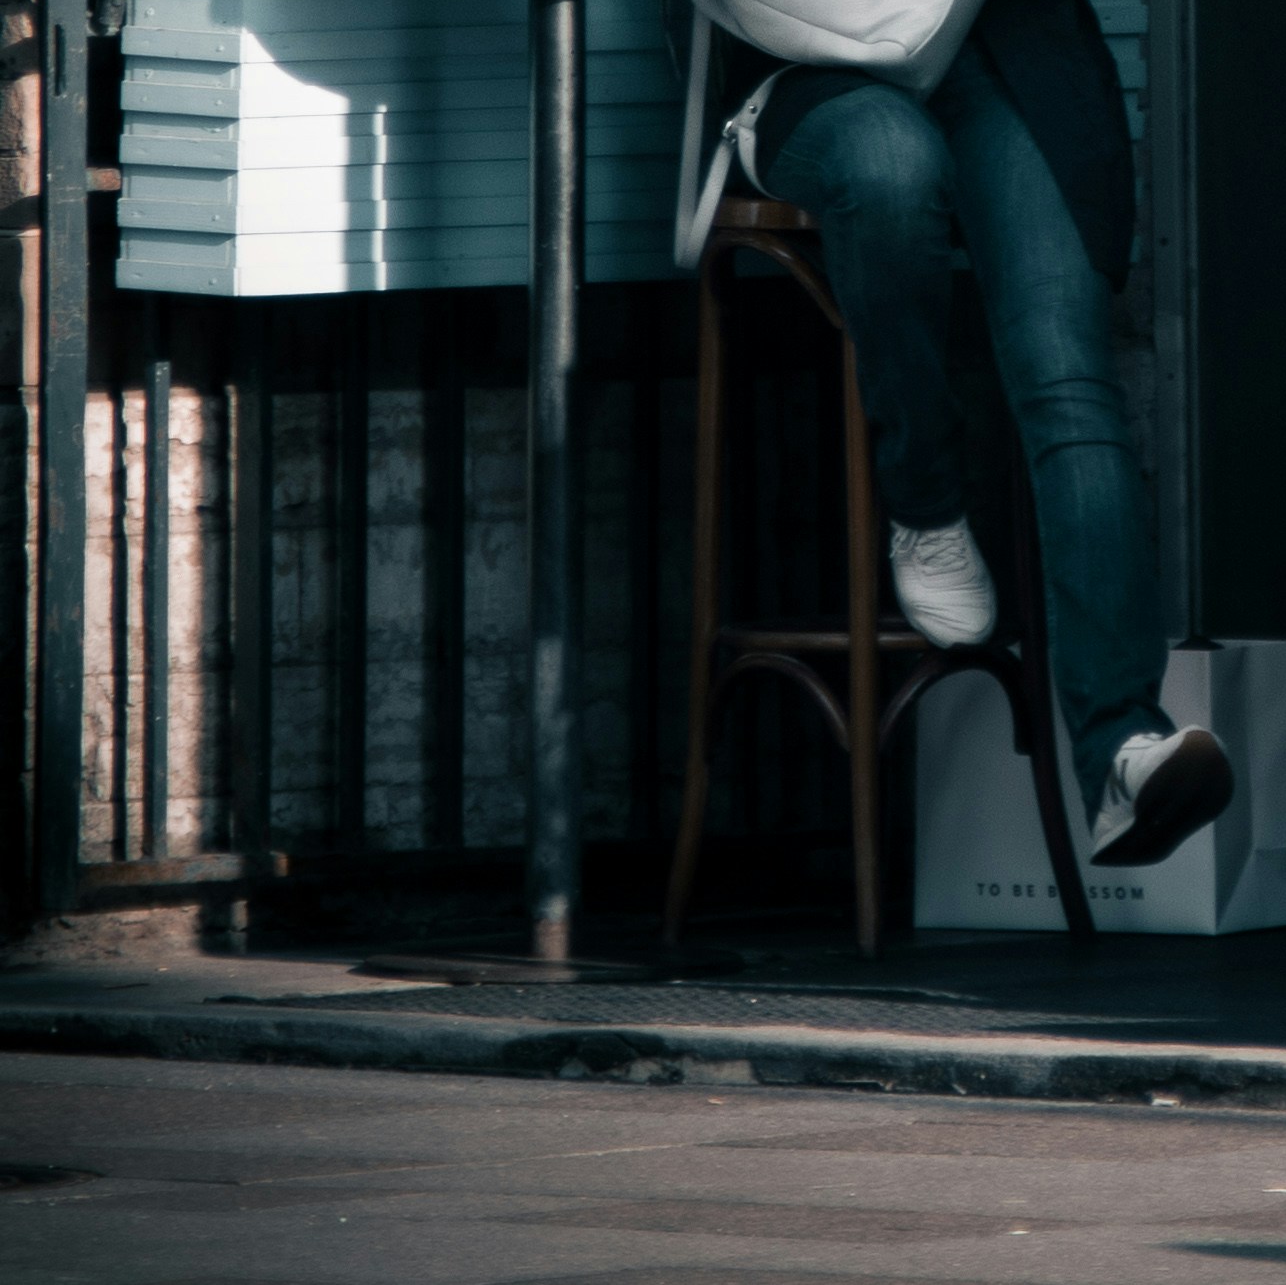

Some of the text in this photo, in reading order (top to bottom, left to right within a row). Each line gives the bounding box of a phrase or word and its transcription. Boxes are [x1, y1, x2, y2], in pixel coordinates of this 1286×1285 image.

[976, 882, 1144, 900] TO BE BSSOM
